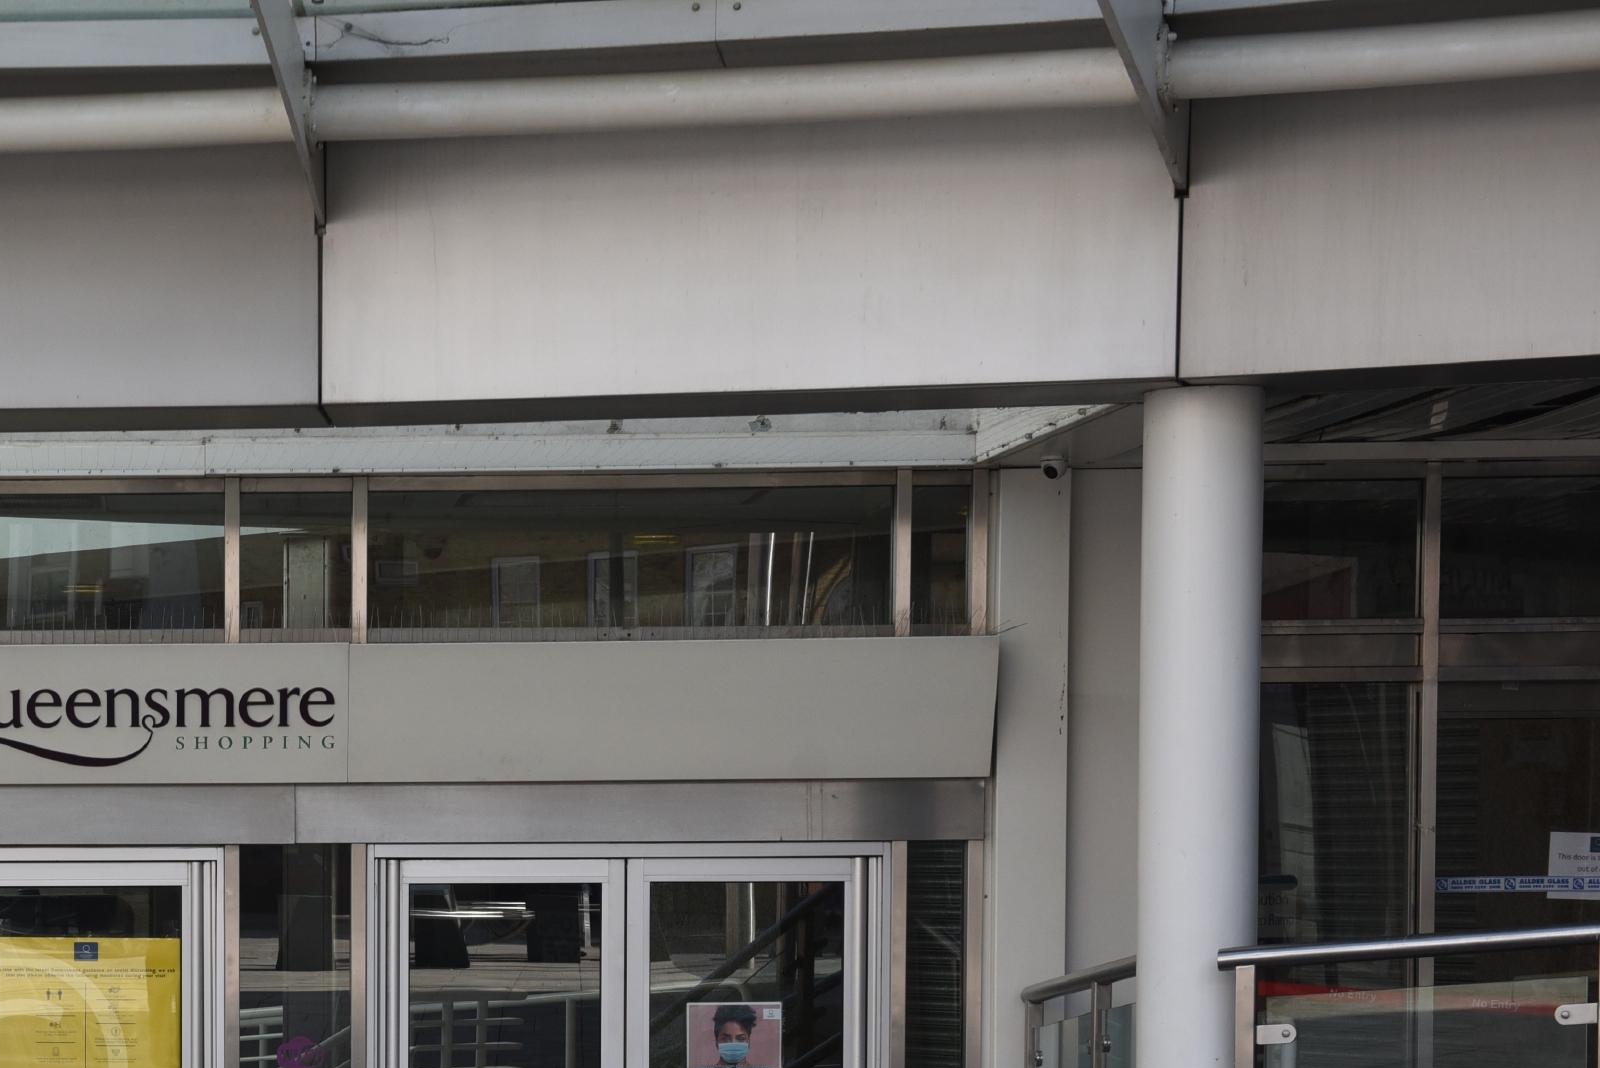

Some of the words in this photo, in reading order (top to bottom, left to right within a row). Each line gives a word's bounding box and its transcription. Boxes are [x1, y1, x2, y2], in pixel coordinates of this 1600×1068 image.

[174, 735, 337, 751] SHOPPING
[1472, 998, 1488, 1008] No
[1490, 999, 1520, 1012] Entry
